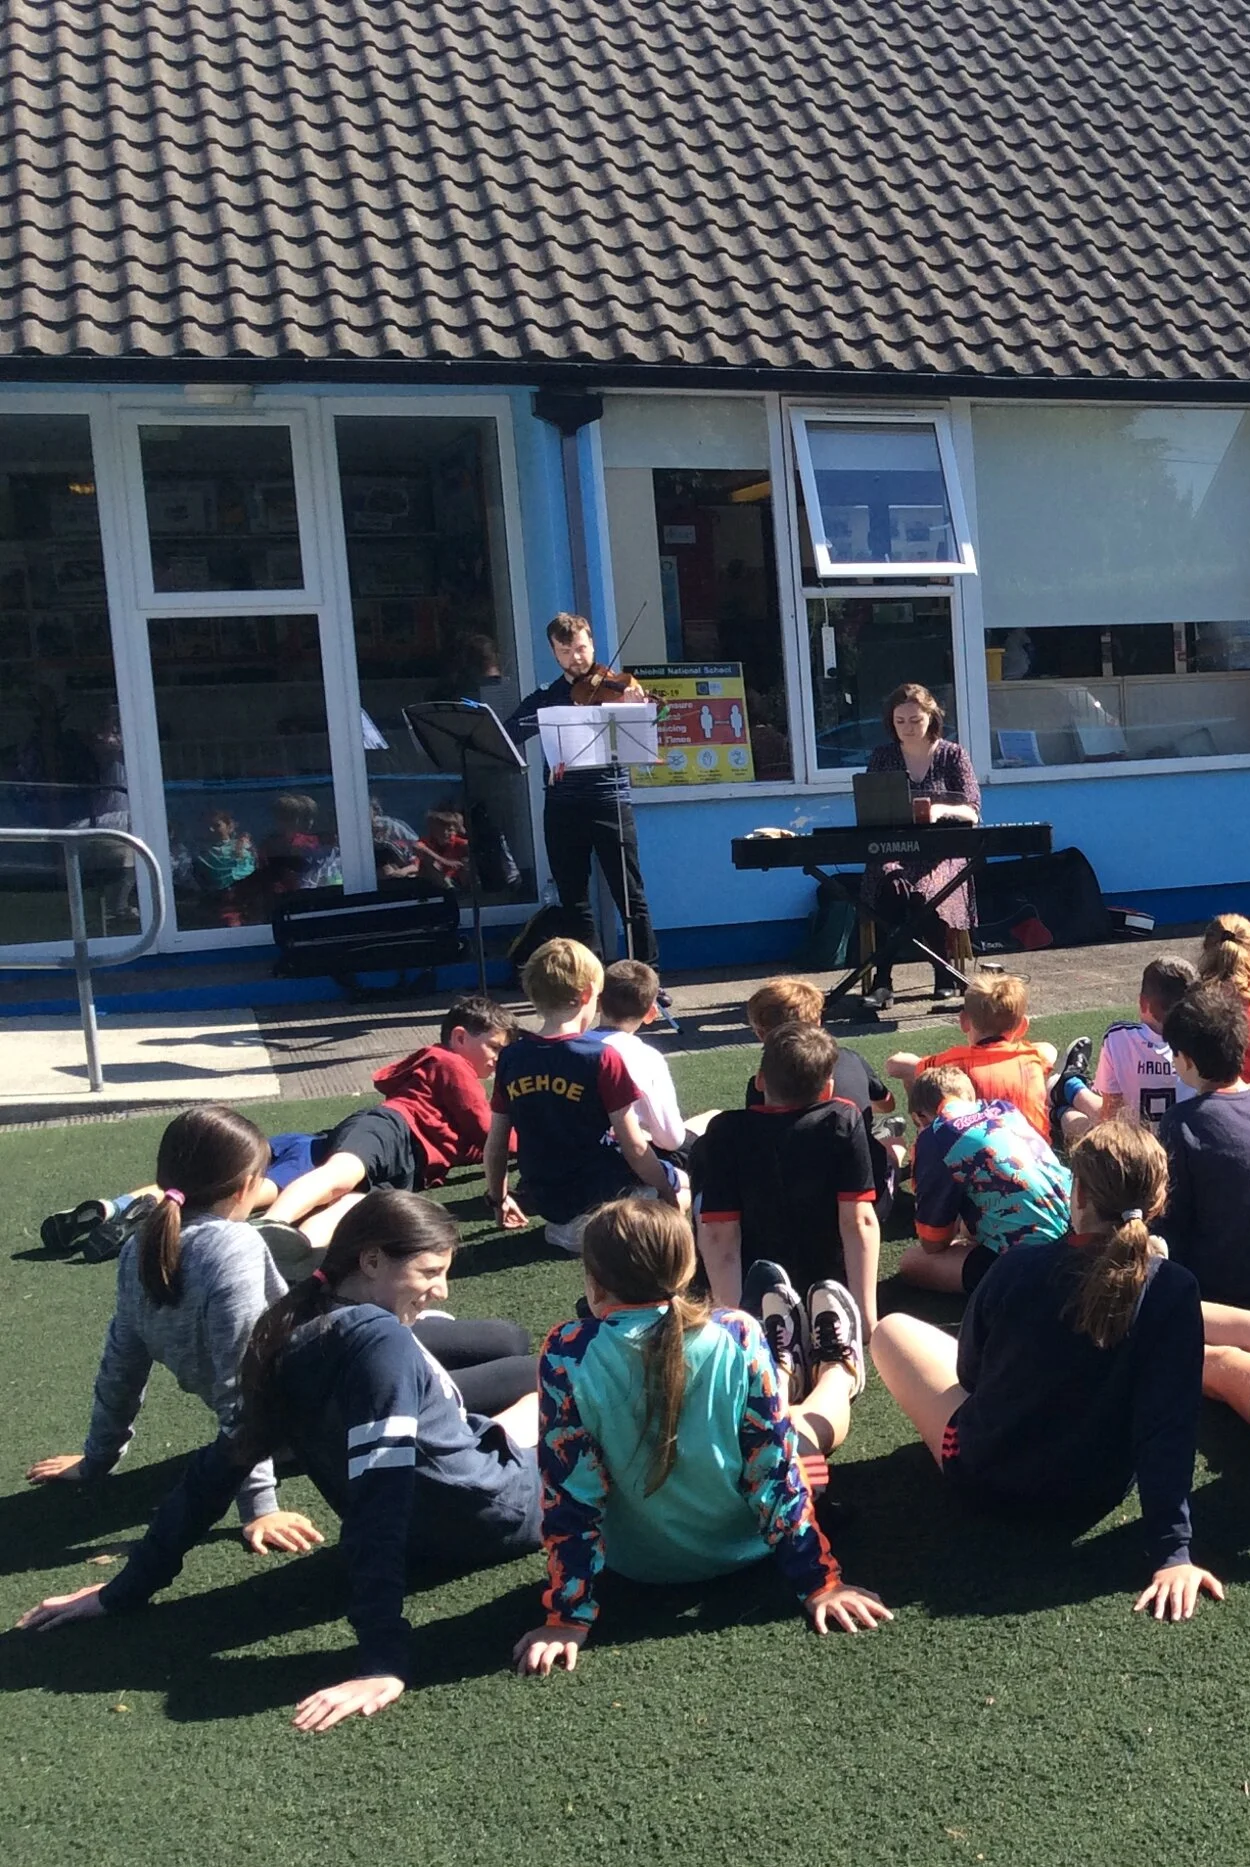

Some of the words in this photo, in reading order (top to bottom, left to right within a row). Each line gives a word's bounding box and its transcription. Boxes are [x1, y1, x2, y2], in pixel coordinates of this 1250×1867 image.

[667, 666, 701, 675] National
[704, 666, 732, 674] School
[880, 840, 921, 854] YAMAHA
[506, 1073, 585, 1103] KEHOE
